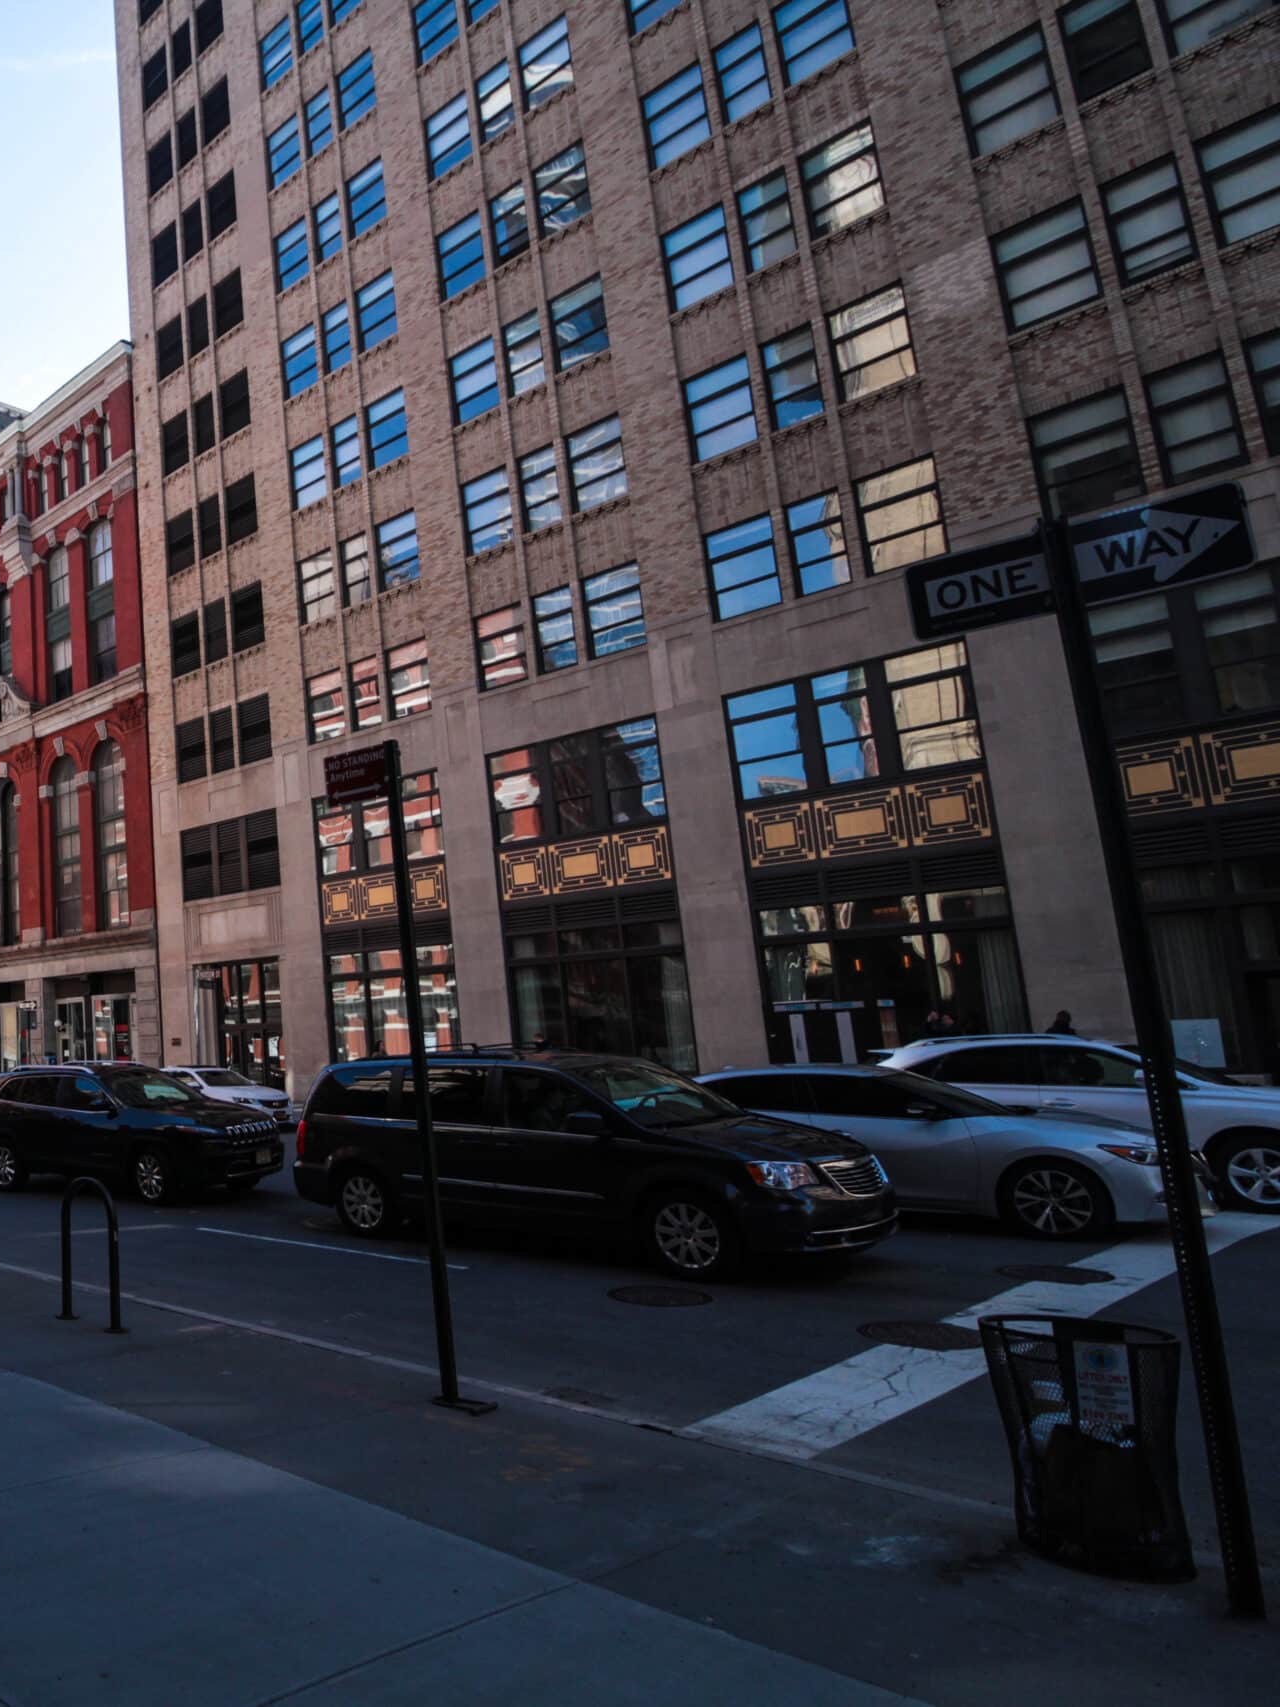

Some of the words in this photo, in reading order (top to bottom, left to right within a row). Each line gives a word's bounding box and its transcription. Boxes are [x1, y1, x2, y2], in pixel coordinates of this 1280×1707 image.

[936, 561, 1038, 609] ONE
[1094, 518, 1200, 573] WAY
[328, 759, 341, 771] NO
[330, 768, 366, 784] Anytime
